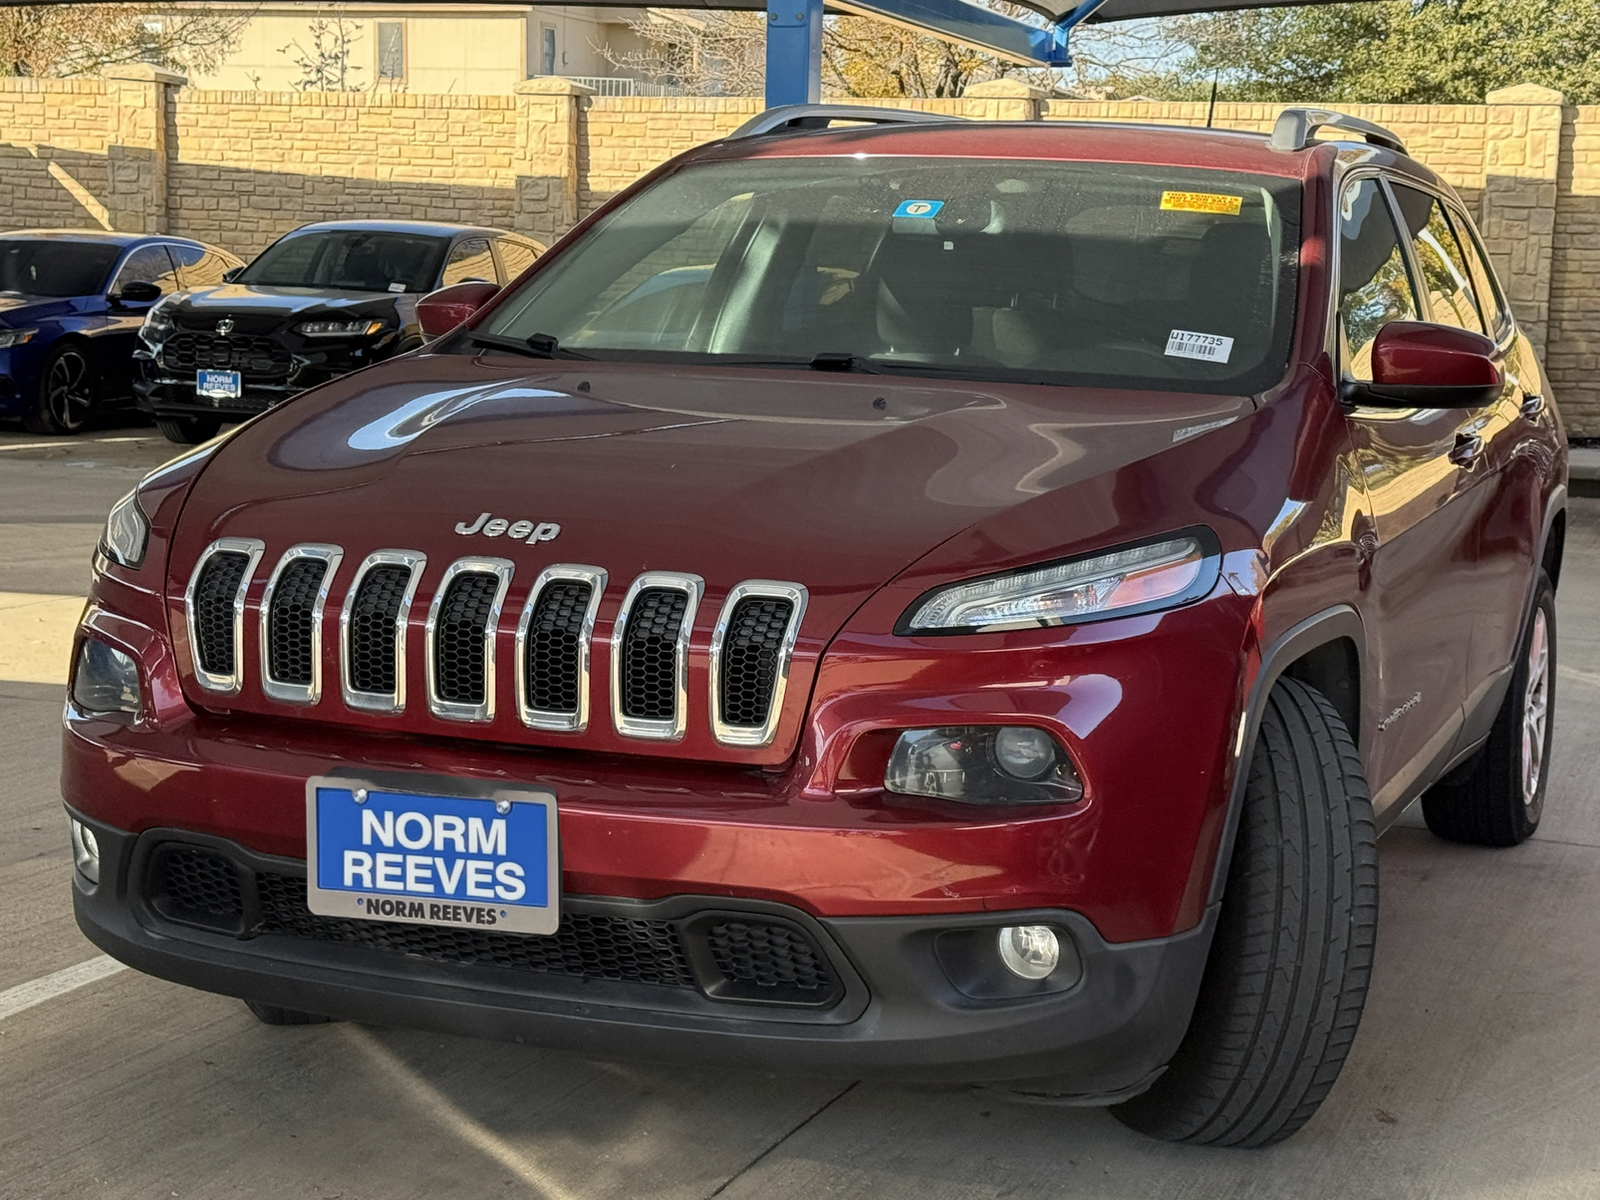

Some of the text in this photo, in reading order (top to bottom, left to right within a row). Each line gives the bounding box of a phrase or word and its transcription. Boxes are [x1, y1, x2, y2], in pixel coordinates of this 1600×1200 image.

[913, 204, 928, 213] T
[1171, 331, 1223, 346] W177735
[203, 382, 236, 391] REEVES
[206, 374, 233, 384] NORM
[454, 512, 561, 545] Jeep
[362, 809, 507, 856] NORM
[343, 850, 526, 901] REEVES
[366, 898, 498, 926] NORM REEVES
